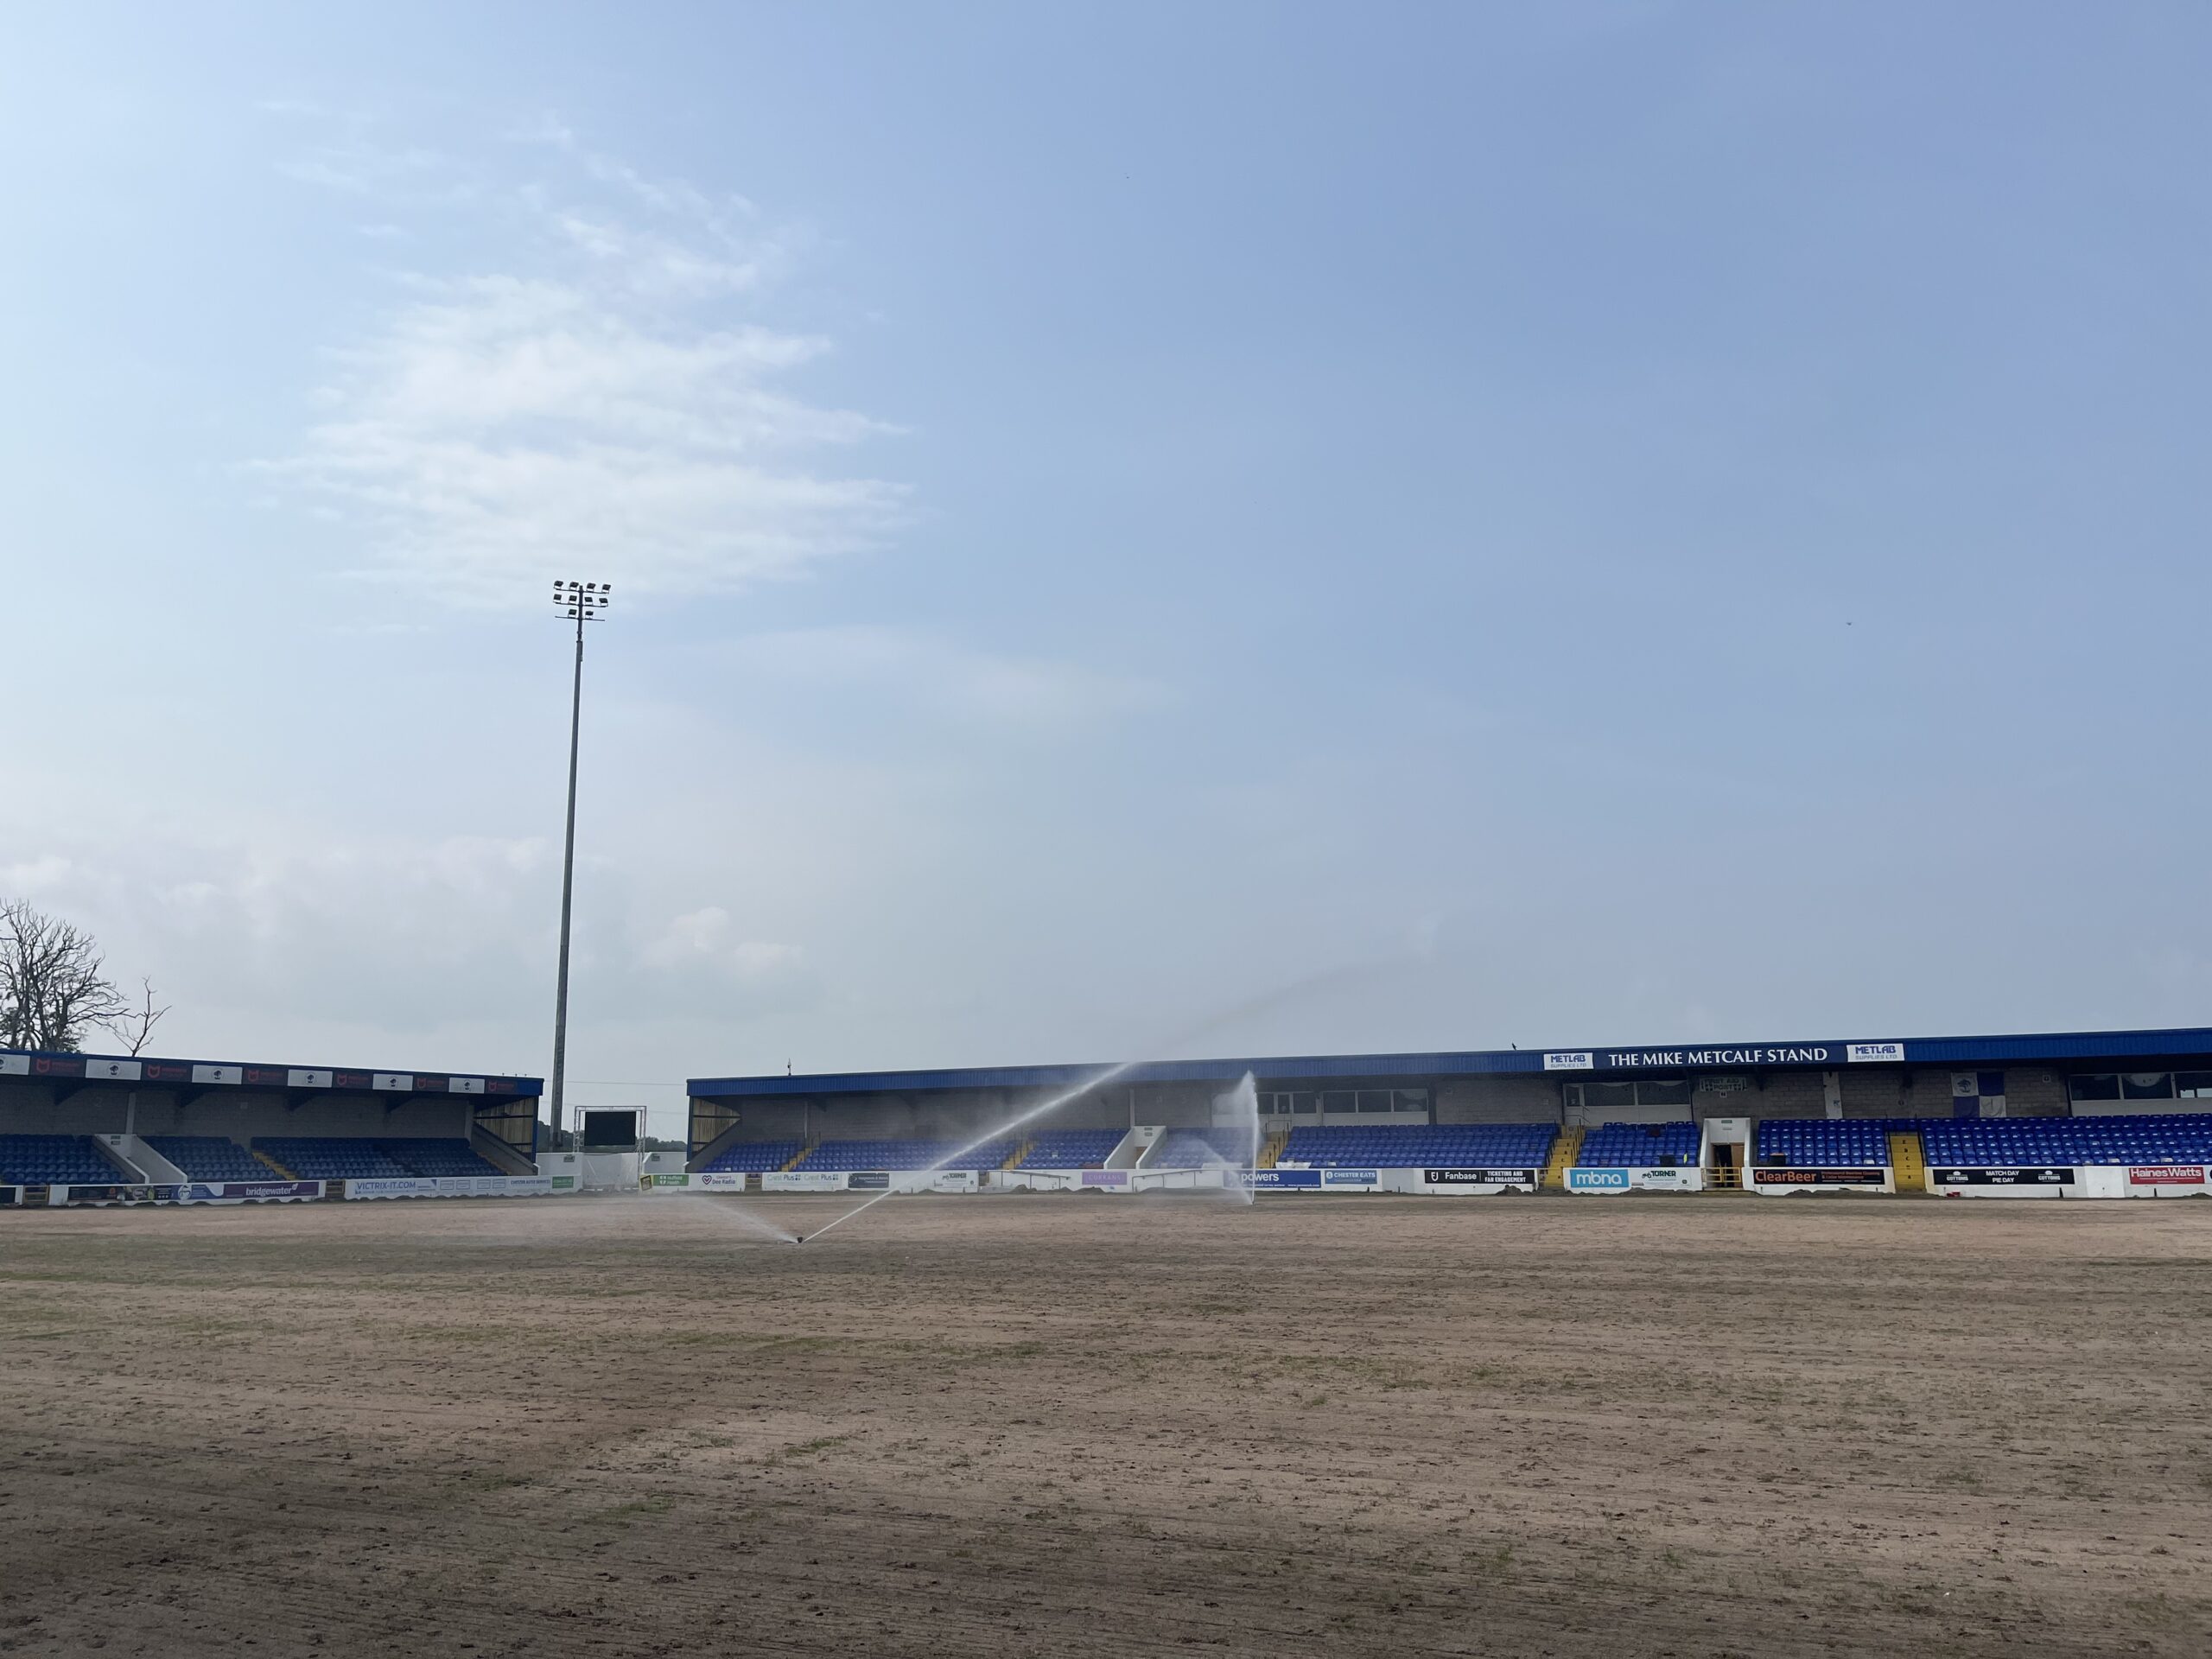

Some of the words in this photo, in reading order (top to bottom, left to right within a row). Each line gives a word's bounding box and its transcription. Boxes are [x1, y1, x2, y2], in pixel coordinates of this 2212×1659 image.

[1855, 1046, 1897, 1054] METLAB
[1609, 1053, 1639, 1067] THE
[1643, 1052, 1683, 1065] MIKE
[1688, 1050, 1762, 1065] METCALF
[1767, 1048, 1828, 1063] STAND
[1241, 1173, 1280, 1183] powers
[1445, 1172, 1477, 1180] Fanbase
[1755, 1171, 1816, 1182] ClearBeer
[2131, 1167, 2166, 1178] Haines
[2168, 1167, 2202, 1177] Watts
[1576, 1172, 1622, 1185] mbna
[357, 1181, 416, 1190] VICTRIX-IT.COM
[245, 1186, 292, 1198] bridgewater
